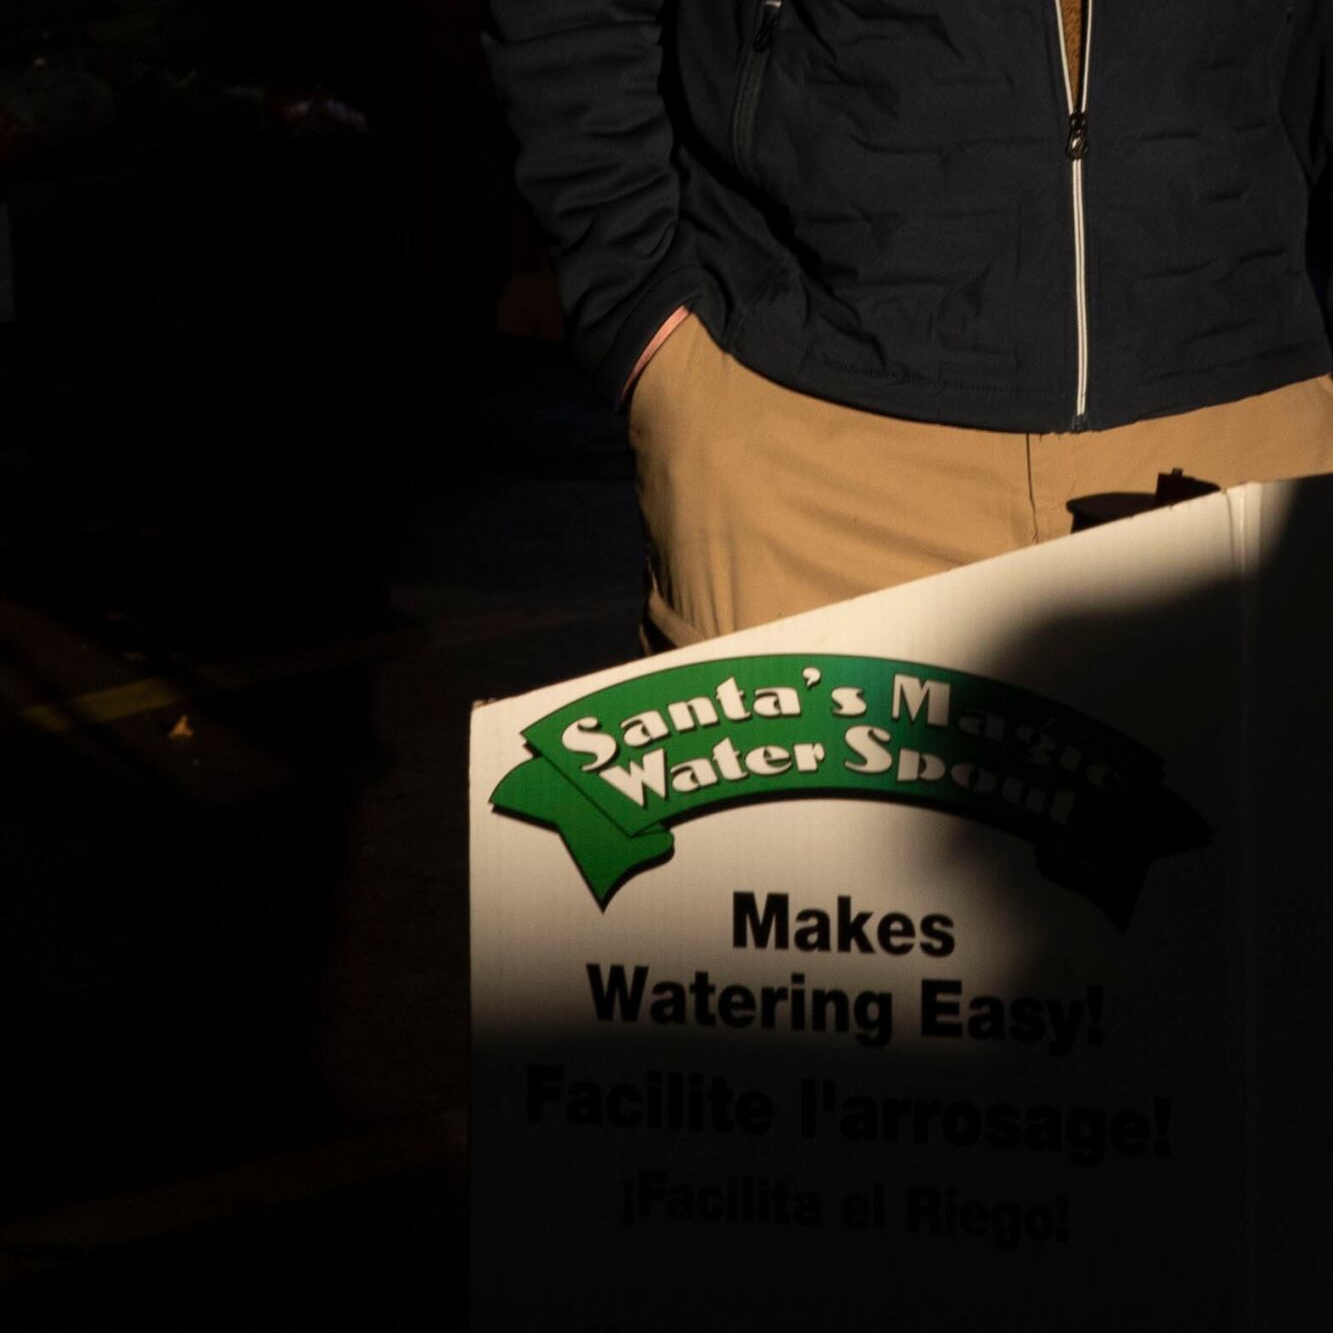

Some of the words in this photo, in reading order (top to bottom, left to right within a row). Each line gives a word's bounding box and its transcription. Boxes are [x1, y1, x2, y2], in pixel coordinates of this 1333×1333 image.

[561, 666, 868, 772] Santa's
[892, 672, 1123, 794] Magic
[598, 736, 826, 808] Water
[844, 724, 1078, 827] Spout
[732, 892, 955, 955] Makes
[586, 965, 893, 1047] Watering
[921, 980, 1104, 1055] Easy!
[527, 1066, 773, 1135] Facilite
[801, 1080, 1171, 1167] l'arrosage!
[622, 1171, 822, 1229] ¡Facilita
[842, 1186, 886, 1231] el
[908, 1185, 1070, 1248] Riego!
